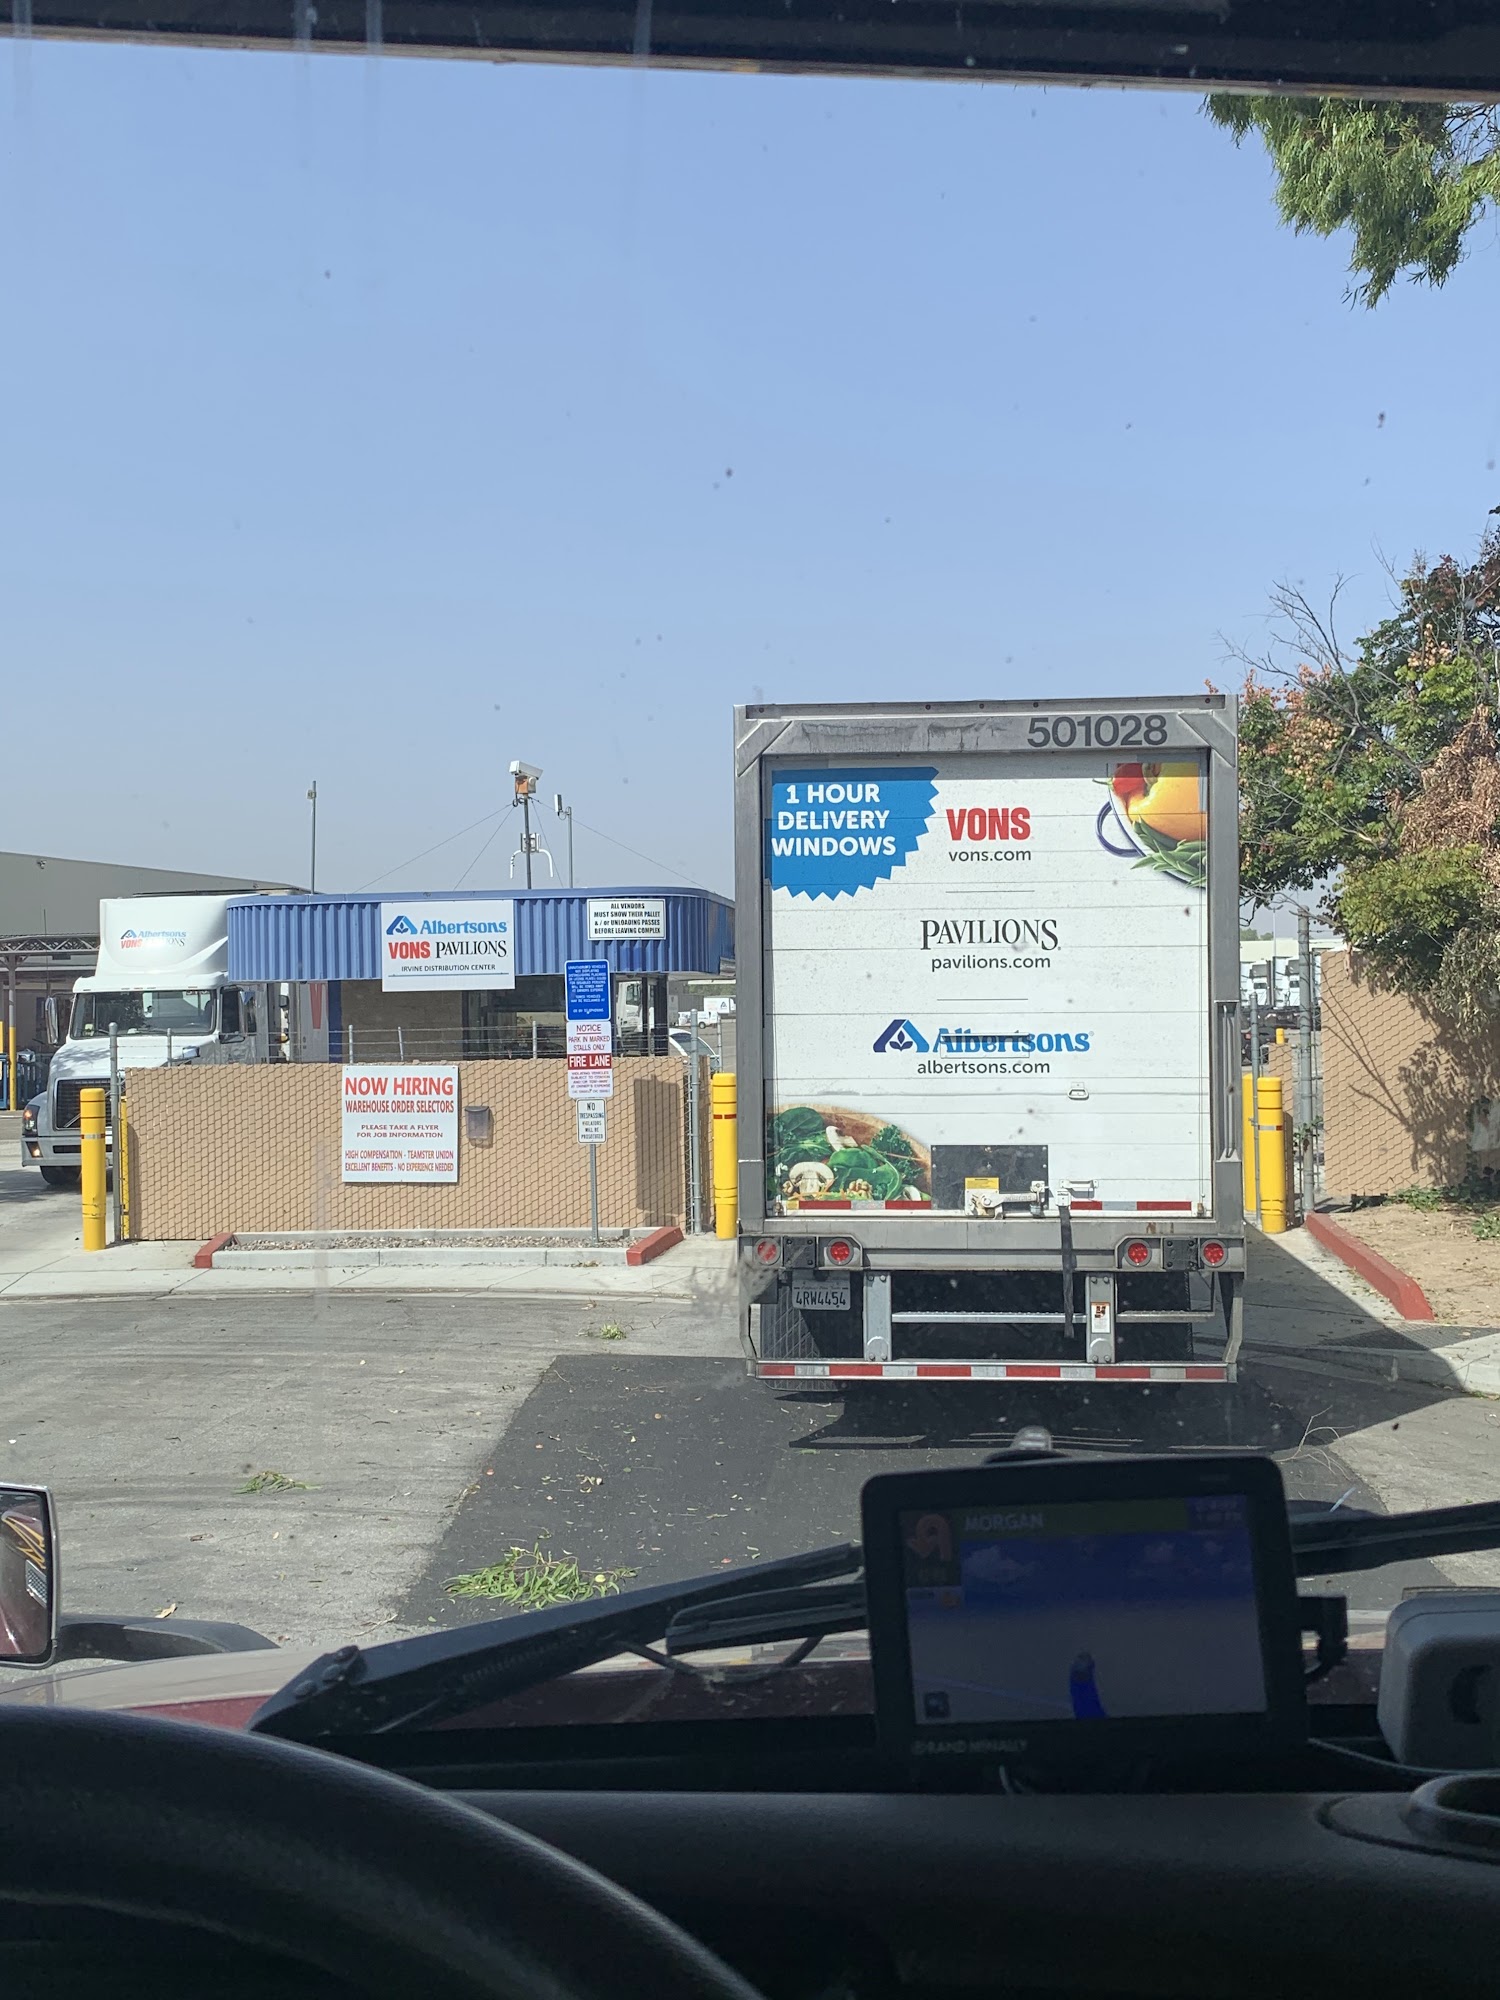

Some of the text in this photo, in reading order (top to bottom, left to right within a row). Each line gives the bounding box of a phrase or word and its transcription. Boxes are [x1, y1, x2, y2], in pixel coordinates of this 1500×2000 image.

[1027, 715, 1168, 747] 501028
[786, 783, 881, 804] 1 HOUR
[777, 809, 890, 831] DELIVERY
[946, 807, 1031, 841] VONS
[771, 836, 897, 857] WINDOWS
[949, 849, 1032, 862] vons.com
[138, 929, 187, 938] Albertsons
[420, 919, 508, 935] Albertsons
[920, 919, 1059, 951] PAVILIONS
[121, 938, 143, 949] VONS
[388, 940, 507, 960] VONS PAVILIONS
[424, 964, 470, 972] DISTRIBUTION
[471, 963, 496, 971] CENTER
[931, 955, 1051, 972] pavilions.com
[576, 1024, 602, 1032] NOTICE
[592, 1043, 606, 1051] ONLY
[932, 1028, 1091, 1053] Albertsons
[569, 1054, 611, 1067] FIRE LANE
[916, 1060, 1051, 1074] albertsons.com
[345, 1076, 454, 1096] NOW HIRING
[345, 1099, 455, 1114] WAREHOUSE ORDER SELECTORS
[586, 1102, 596, 1111] NO
[345, 1150, 358, 1159] HIGH
[359, 1150, 403, 1159] COMPENSATION
[407, 1150, 435, 1159] TEAMSTER
[435, 1150, 454, 1159] UNION
[345, 1162, 371, 1171] EXCELLENT
[371, 1162, 394, 1171] BENEFITS
[397, 1162, 406, 1171] NO
[406, 1162, 434, 1171] EXPERIENCE
[434, 1162, 454, 1171] NEEDED
[796, 1291, 847, 1305] 4RW4454
[964, 1512, 1044, 1532] MORGAN
